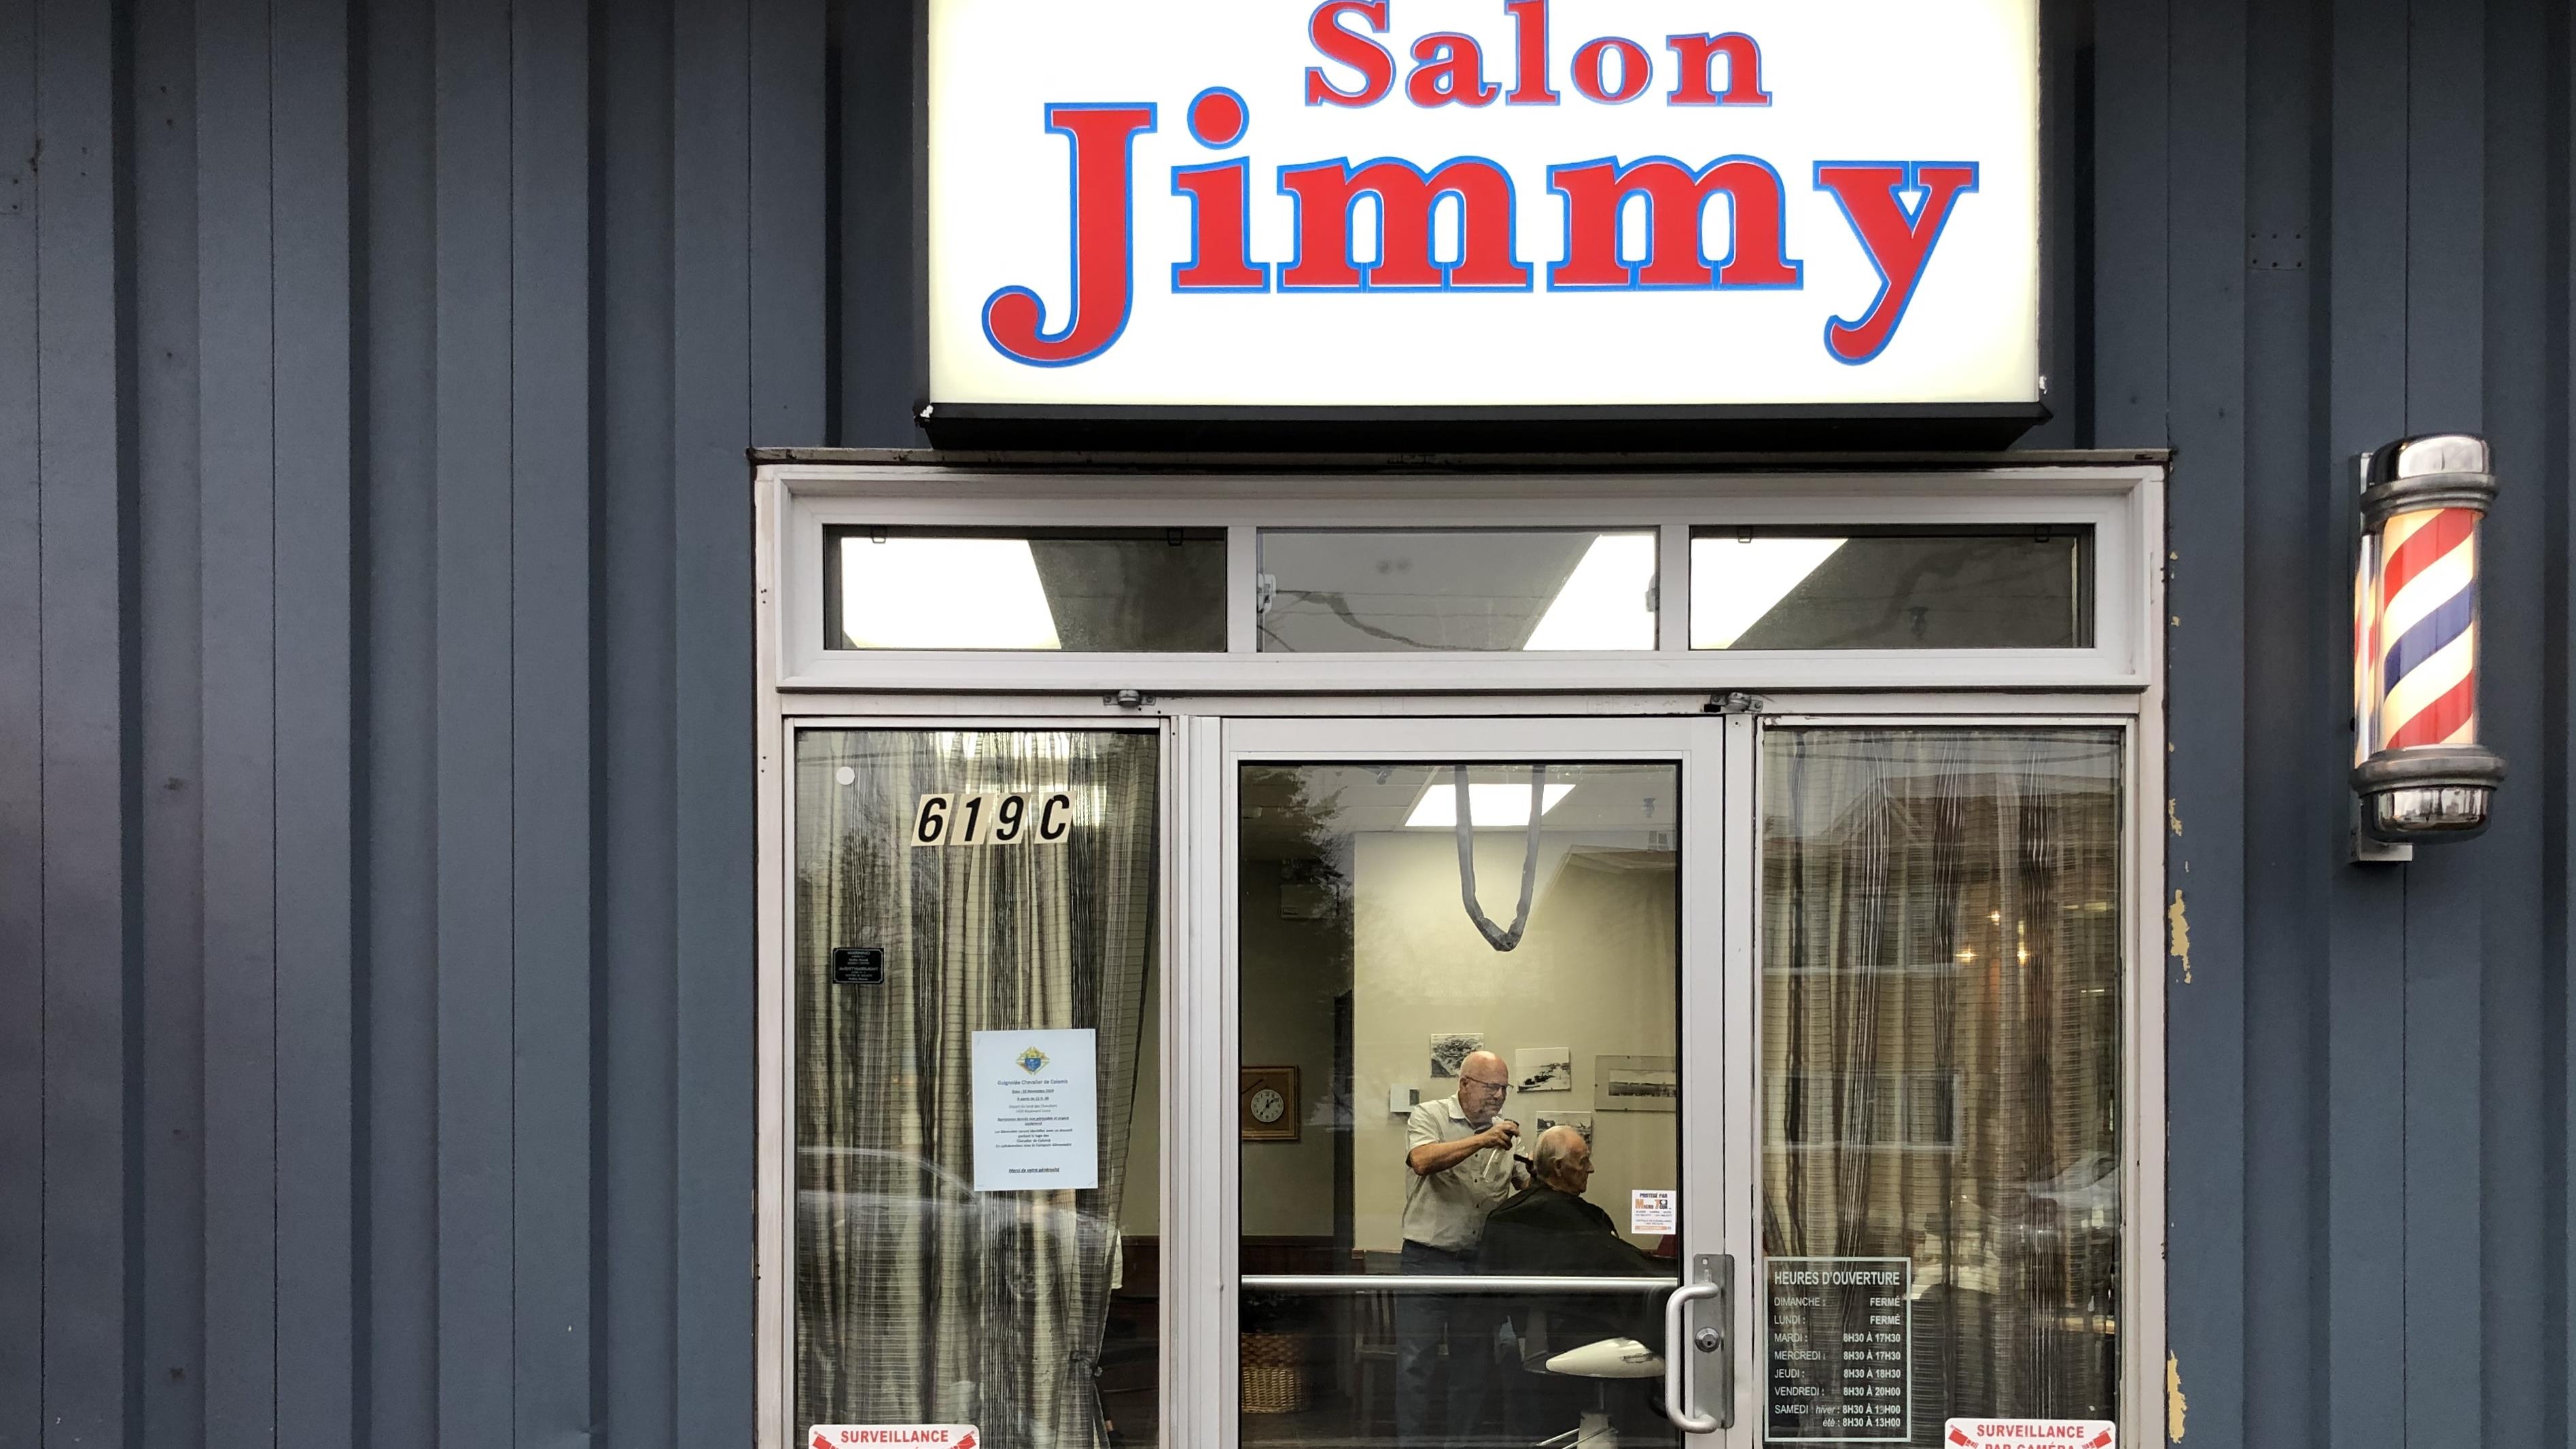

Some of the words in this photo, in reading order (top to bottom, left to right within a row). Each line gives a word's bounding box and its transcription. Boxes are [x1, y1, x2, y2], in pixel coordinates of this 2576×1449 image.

[1305, 0, 1773, 108] Salon
[981, 86, 1980, 368] Jimmy
[1774, 1272, 1818, 1285] HEURES
[1822, 1272, 1900, 1285] D'OUVERTURE
[1774, 1297, 1820, 1306] DIMANCHE
[1870, 1296, 1901, 1306] FERMÉ
[1774, 1315, 1801, 1325] LUNDI
[1870, 1314, 1901, 1325] FERMÉ
[1774, 1333, 1802, 1342] MARDI
[1843, 1333, 1865, 1342] 8H30
[1866, 1331, 1873, 1342] À
[1875, 1333, 1901, 1342] 17H30
[1774, 1351, 1820, 1360] MERCREDI
[1843, 1351, 1865, 1360] 8H30
[1866, 1349, 1873, 1360] À
[1875, 1351, 1901, 1360] 17H30
[1774, 1369, 1799, 1378] JEUDI
[1843, 1369, 1865, 1378] 8H30
[1866, 1367, 1873, 1378] À
[1875, 1369, 1901, 1378] 18H30
[1774, 1386, 1819, 1396] VENDREDI
[1843, 1386, 1865, 1396] 8H30
[1866, 1384, 1873, 1396] À
[1875, 1386, 1901, 1396] 20H00
[1774, 1404, 1809, 1414] SAMEDI
[1816, 1405, 1835, 1414] hiver
[1842, 1404, 1864, 1414] 8H30
[1865, 1402, 1873, 1414] À
[1842, 1418, 1864, 1427] 8H30
[1865, 1415, 1873, 1427] À
[1875, 1418, 1901, 1427] 13H00
[841, 1429, 949, 1443] SURVEILLANCE
[1977, 1424, 2084, 1438] SURVEILLANCE
